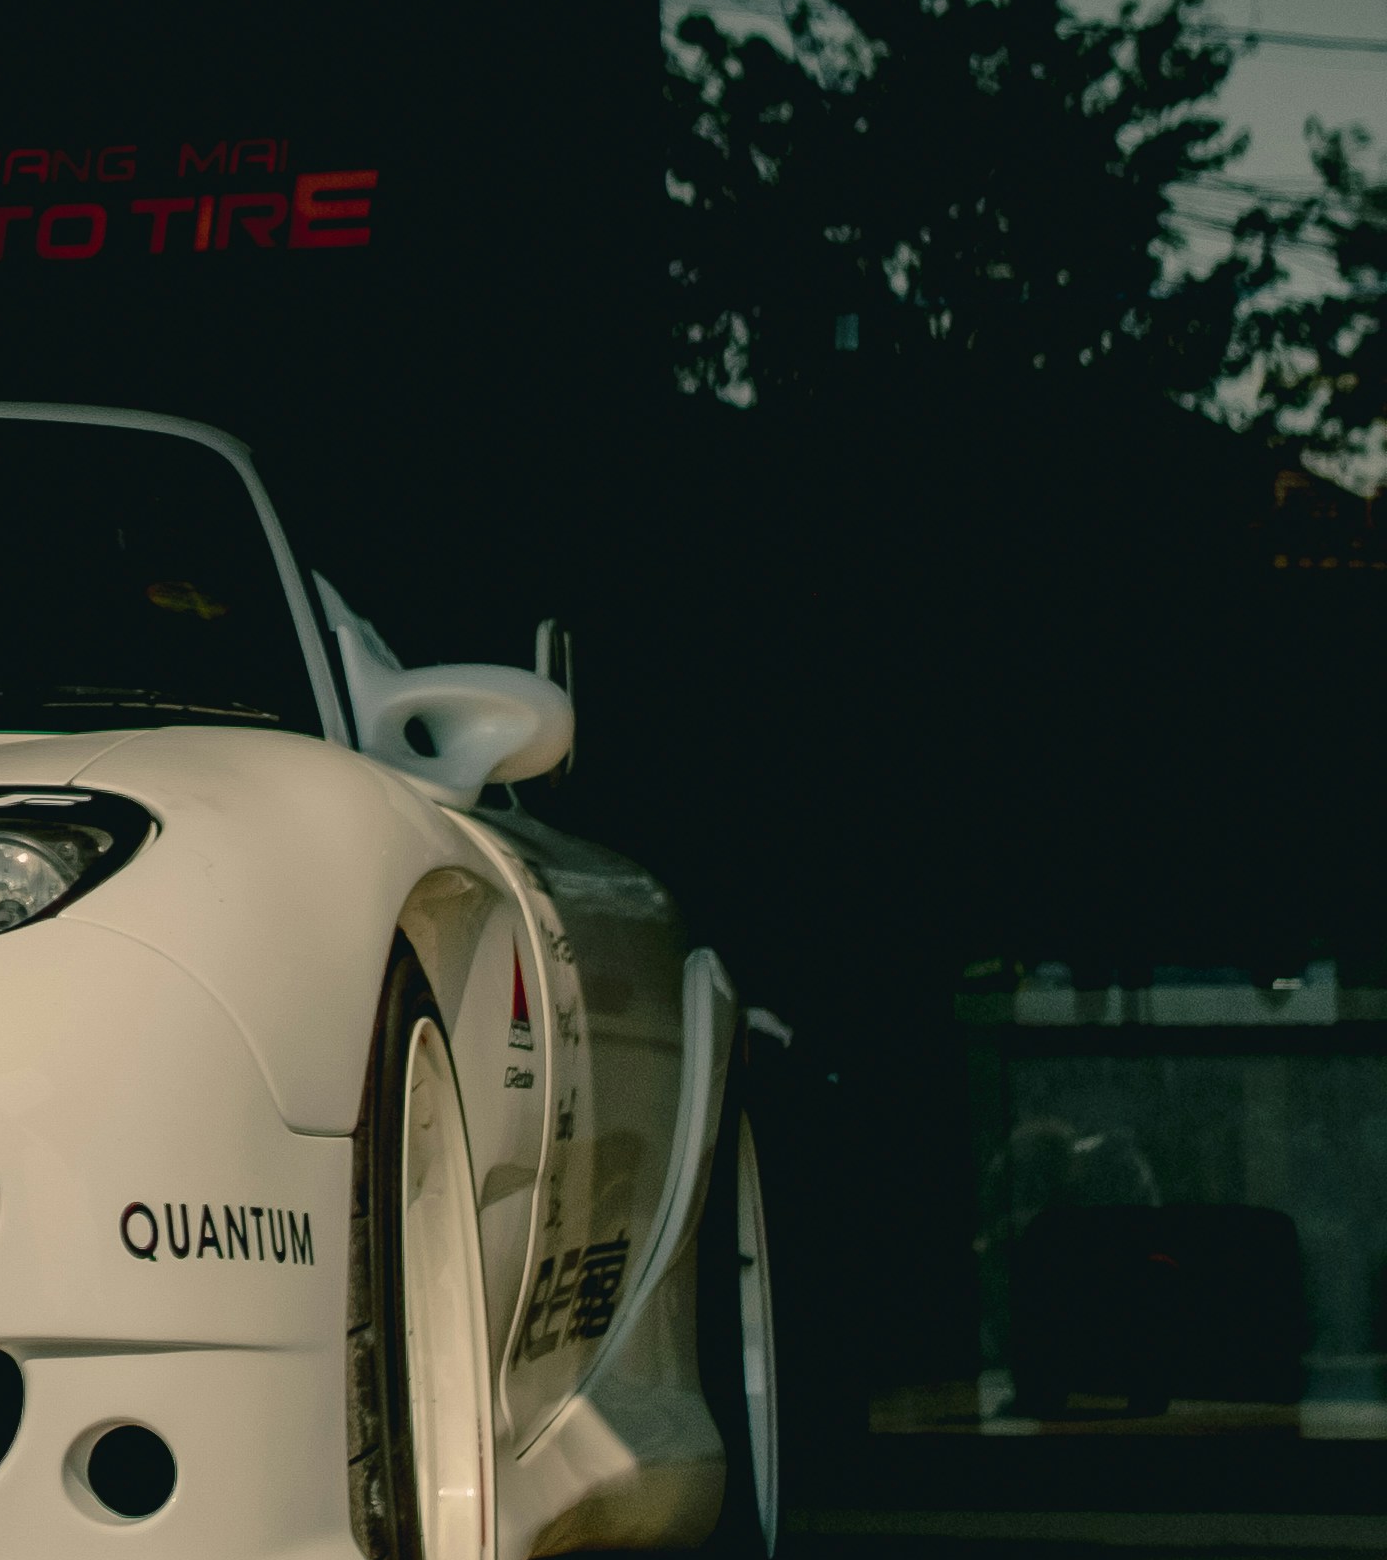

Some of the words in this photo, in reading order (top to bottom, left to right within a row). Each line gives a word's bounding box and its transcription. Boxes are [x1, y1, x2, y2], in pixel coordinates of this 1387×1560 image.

[177, 137, 289, 178] MAI
[131, 168, 380, 255] TIRE
[119, 1201, 315, 1266] QUANTUM
